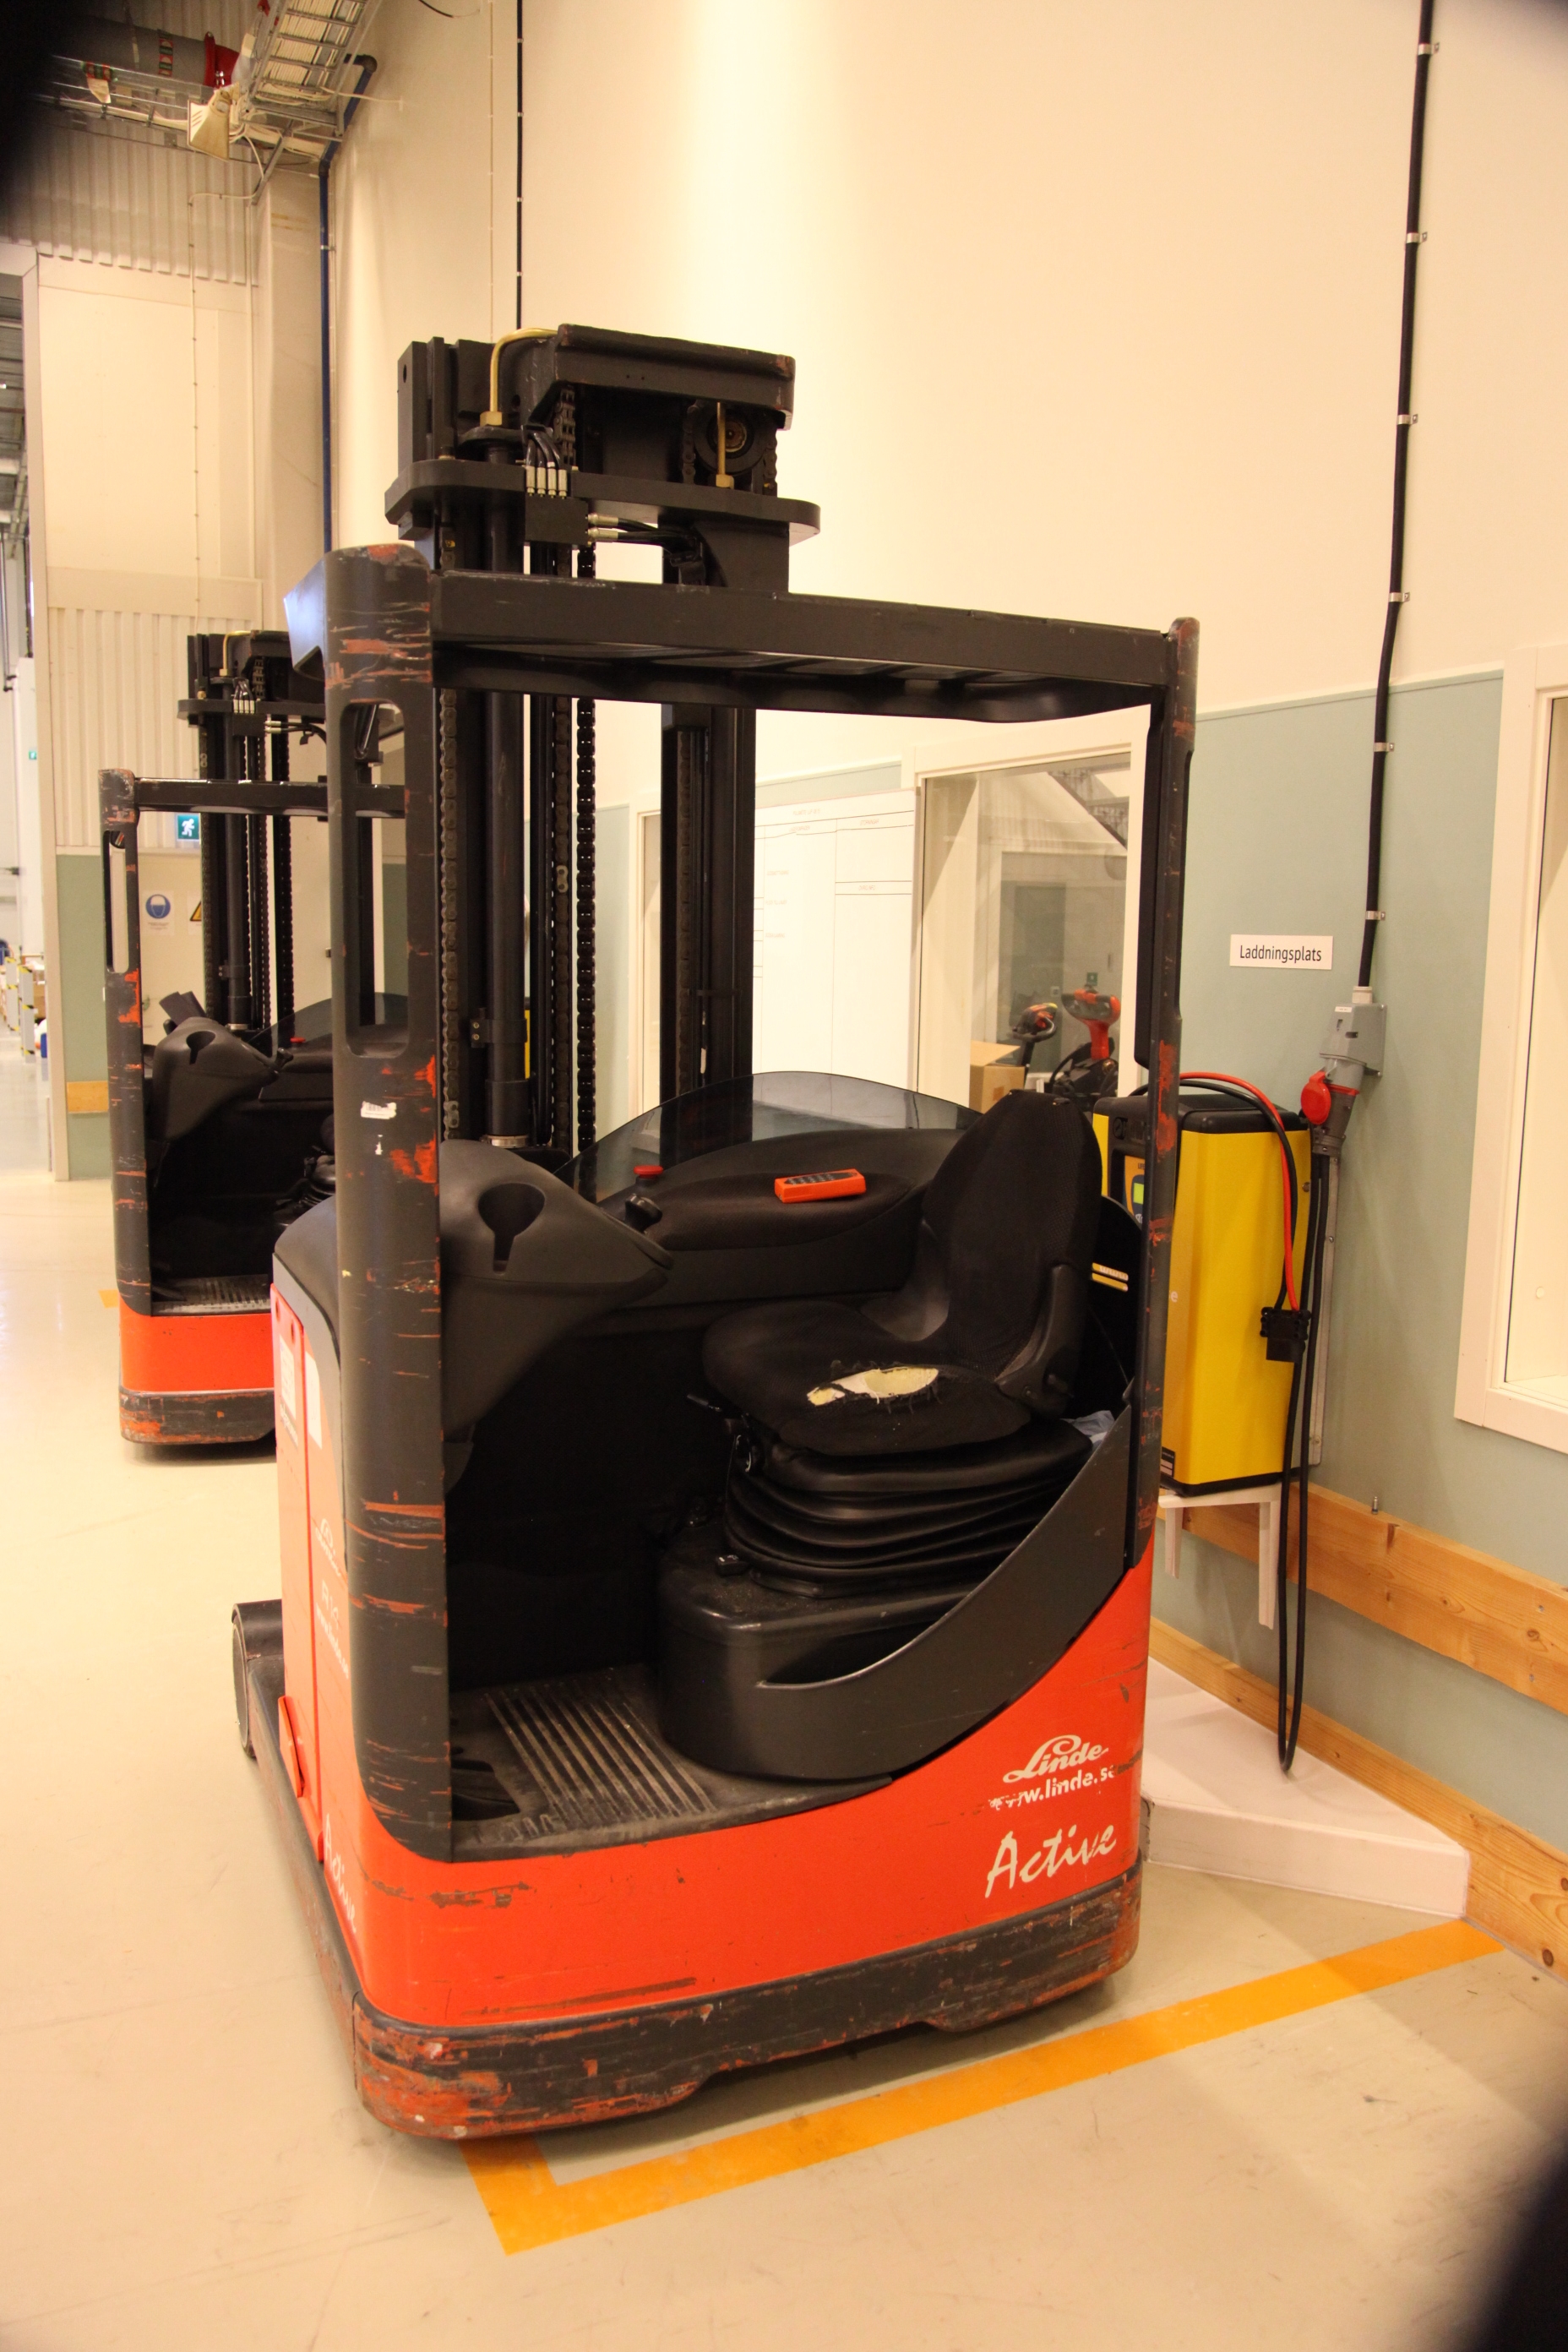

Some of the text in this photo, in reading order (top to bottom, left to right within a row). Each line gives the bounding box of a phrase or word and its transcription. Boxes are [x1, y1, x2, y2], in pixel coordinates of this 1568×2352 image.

[1239, 945, 1322, 964] Laddningsplats
[1003, 1734, 1109, 1783] Linde
[324, 1813, 357, 1934] Active
[984, 1824, 1117, 1899] Active
